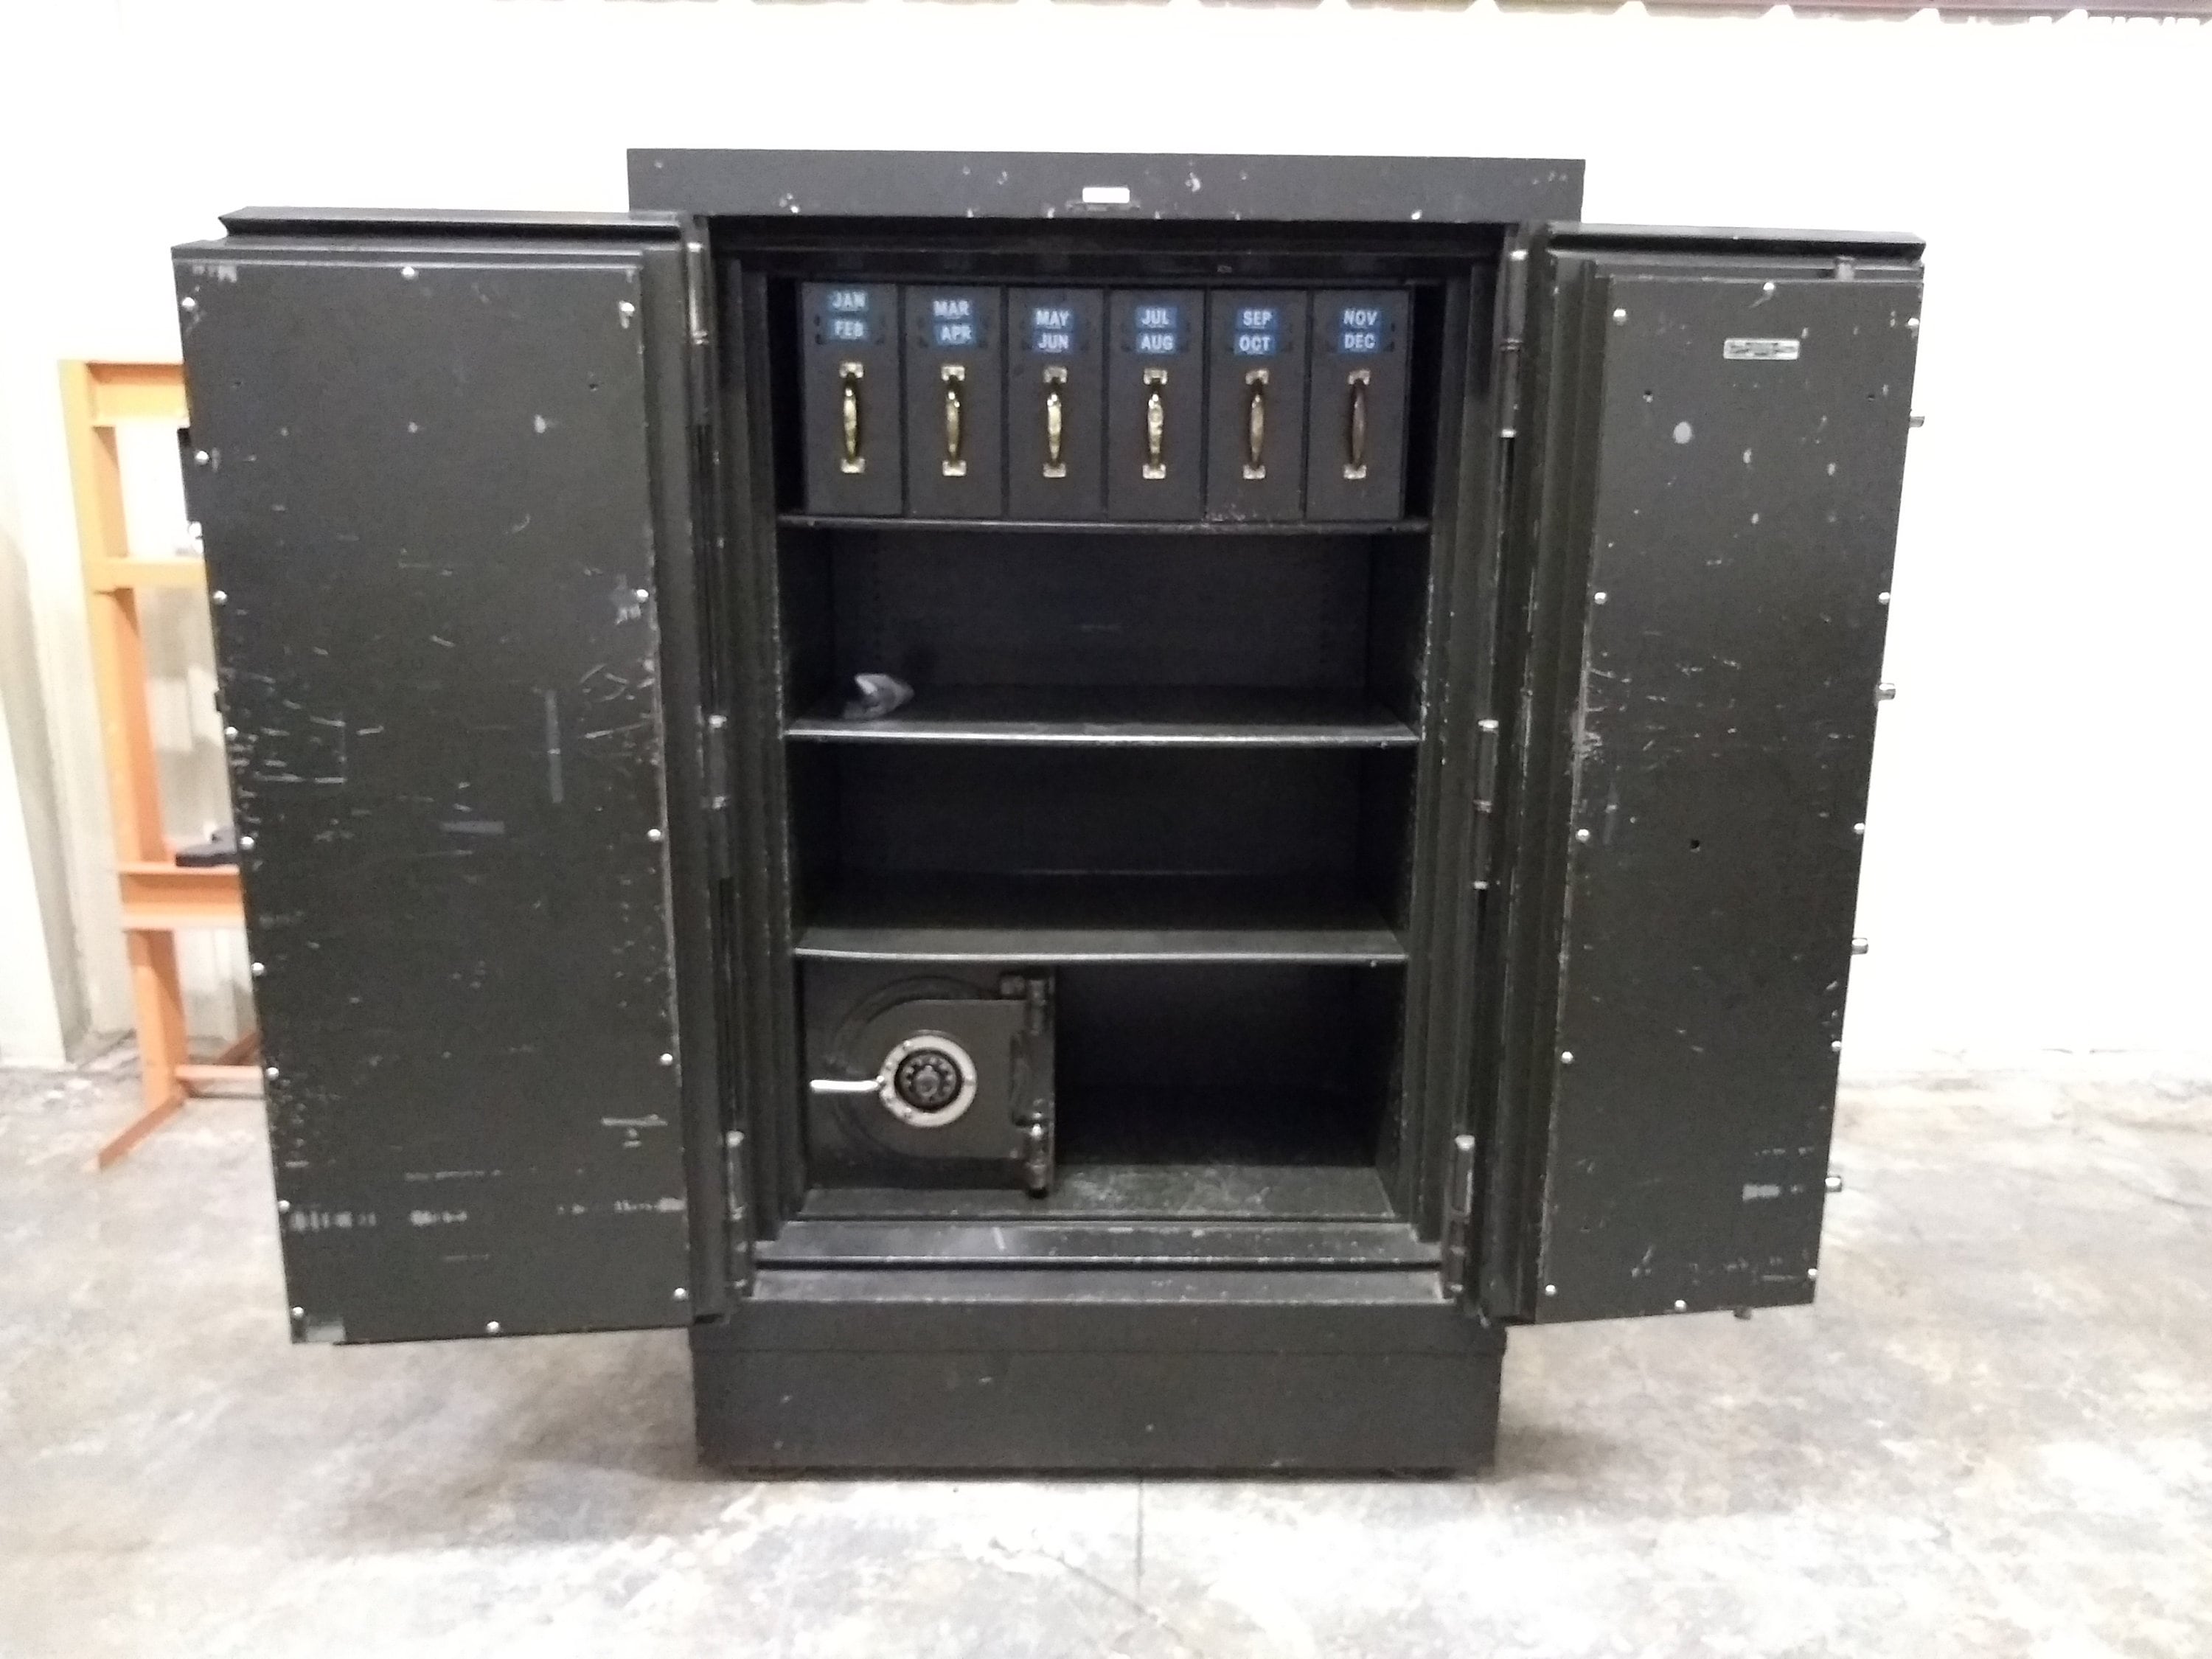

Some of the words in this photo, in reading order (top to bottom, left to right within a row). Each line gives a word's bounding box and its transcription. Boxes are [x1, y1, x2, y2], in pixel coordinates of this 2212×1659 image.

[832, 292, 866, 307] JAN
[933, 300, 970, 316] MAR
[1036, 310, 1069, 326] MAY
[1142, 309, 1169, 324] JUL
[1243, 310, 1272, 326] SEP
[1343, 310, 1377, 325] NOV
[835, 320, 863, 337] FEB
[940, 324, 972, 340] APR
[1038, 333, 1068, 349] JUN
[1141, 333, 1174, 350] AUG
[1239, 334, 1270, 351] OCT
[1344, 333, 1375, 349] DEC
